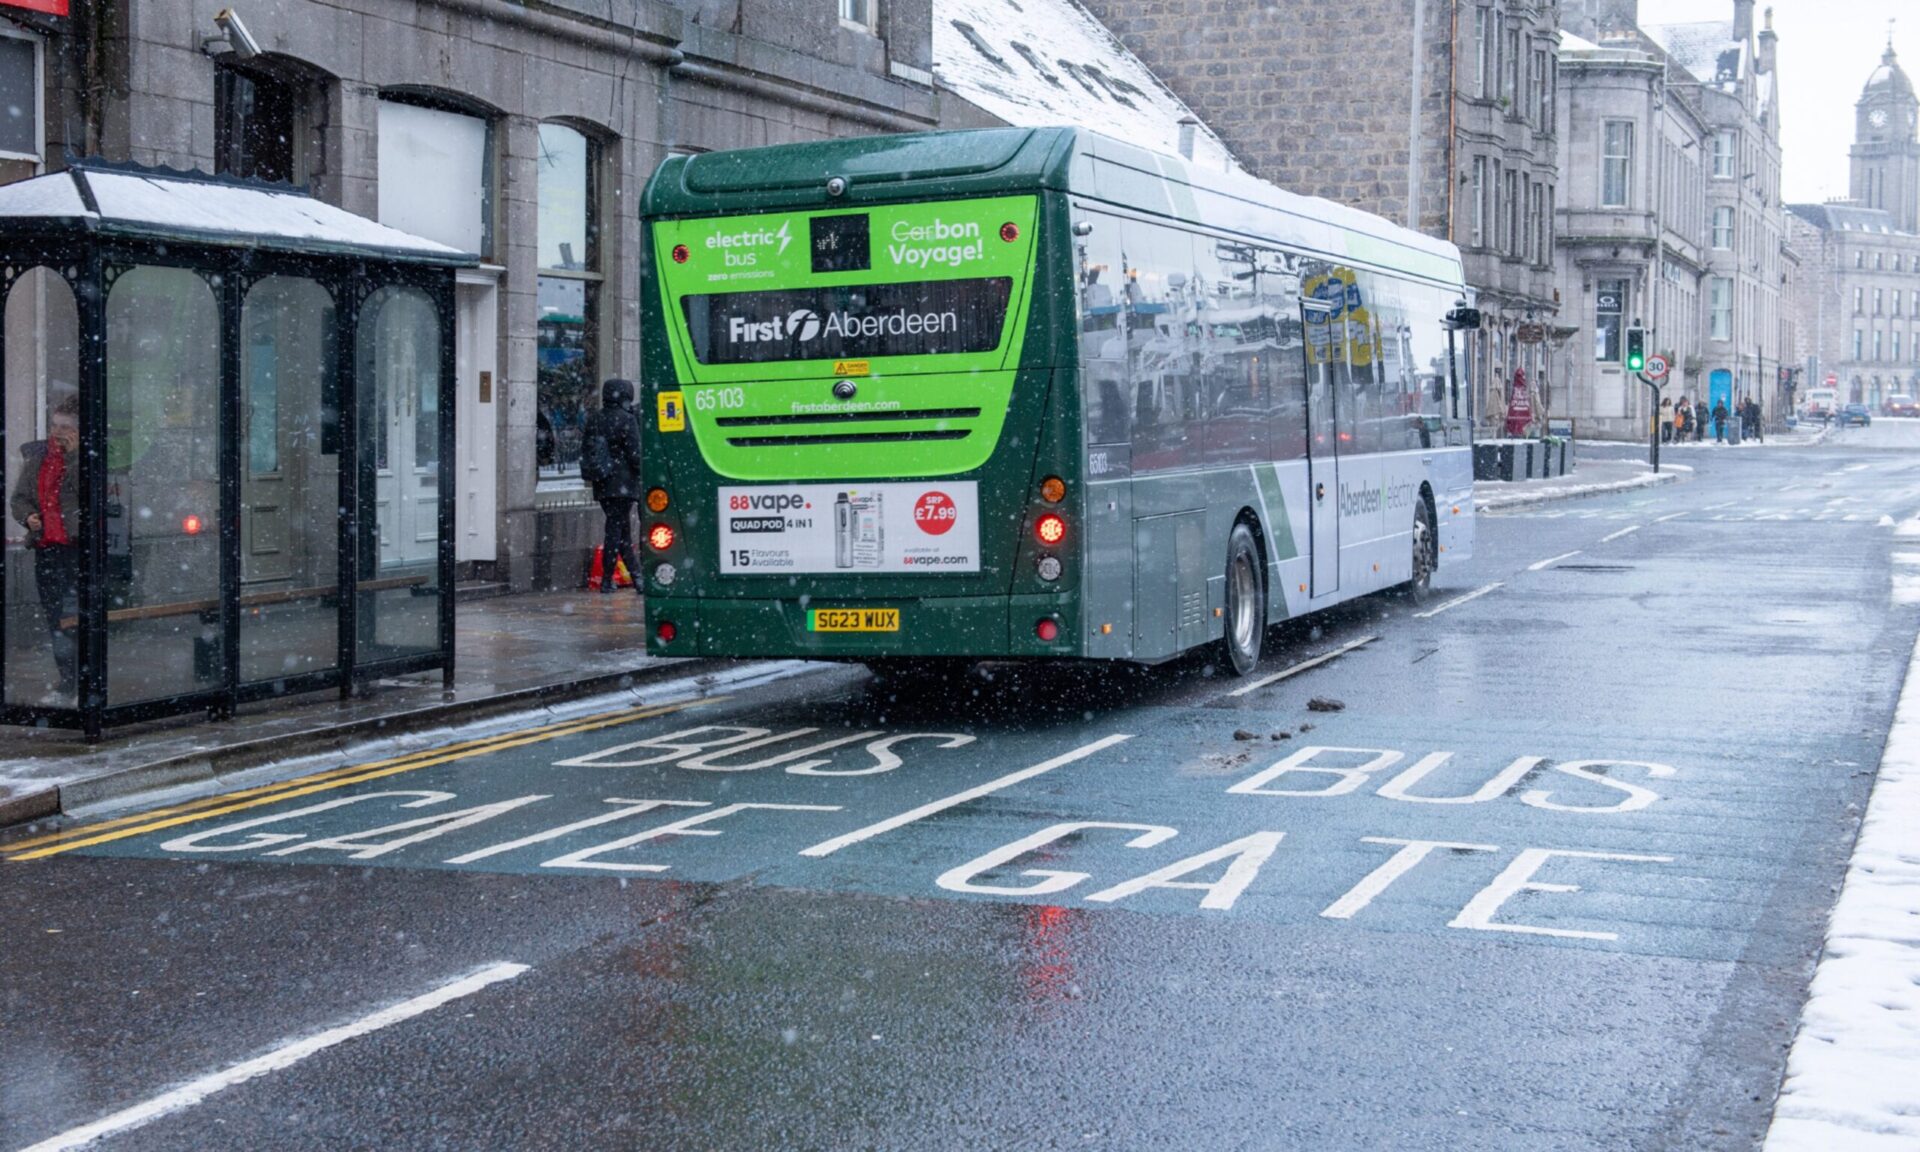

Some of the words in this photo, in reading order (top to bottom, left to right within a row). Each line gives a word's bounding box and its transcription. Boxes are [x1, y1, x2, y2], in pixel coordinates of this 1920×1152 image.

[705, 228, 775, 249] electric
[891, 218, 980, 242] Carbon
[724, 249, 757, 267] bus
[888, 238, 984, 269] Voyage!
[730, 316, 783, 343] First
[823, 308, 957, 338] Aberdeen
[1648, 361, 1664, 372] 30
[791, 400, 901, 413] firstaberdeen.com
[926, 495, 944, 504] SRP
[1340, 479, 1382, 518] Aberdeen
[915, 504, 956, 520] £7.99
[732, 519, 761, 532] QUAD
[761, 519, 783, 530] POD
[786, 519, 793, 529] 4
[795, 519, 807, 528] IN
[807, 518, 813, 528] 1
[730, 549, 751, 567] 15
[751, 549, 790, 558] Flavours
[751, 558, 795, 567] Available
[903, 556, 969, 567] 88vape.com
[818, 612, 860, 628] SG23
[864, 611, 896, 628] WUX
[552, 725, 976, 777] BUS
[1227, 745, 1676, 813] BUS
[160, 790, 842, 873] GATE
[935, 821, 1674, 941] GATE
